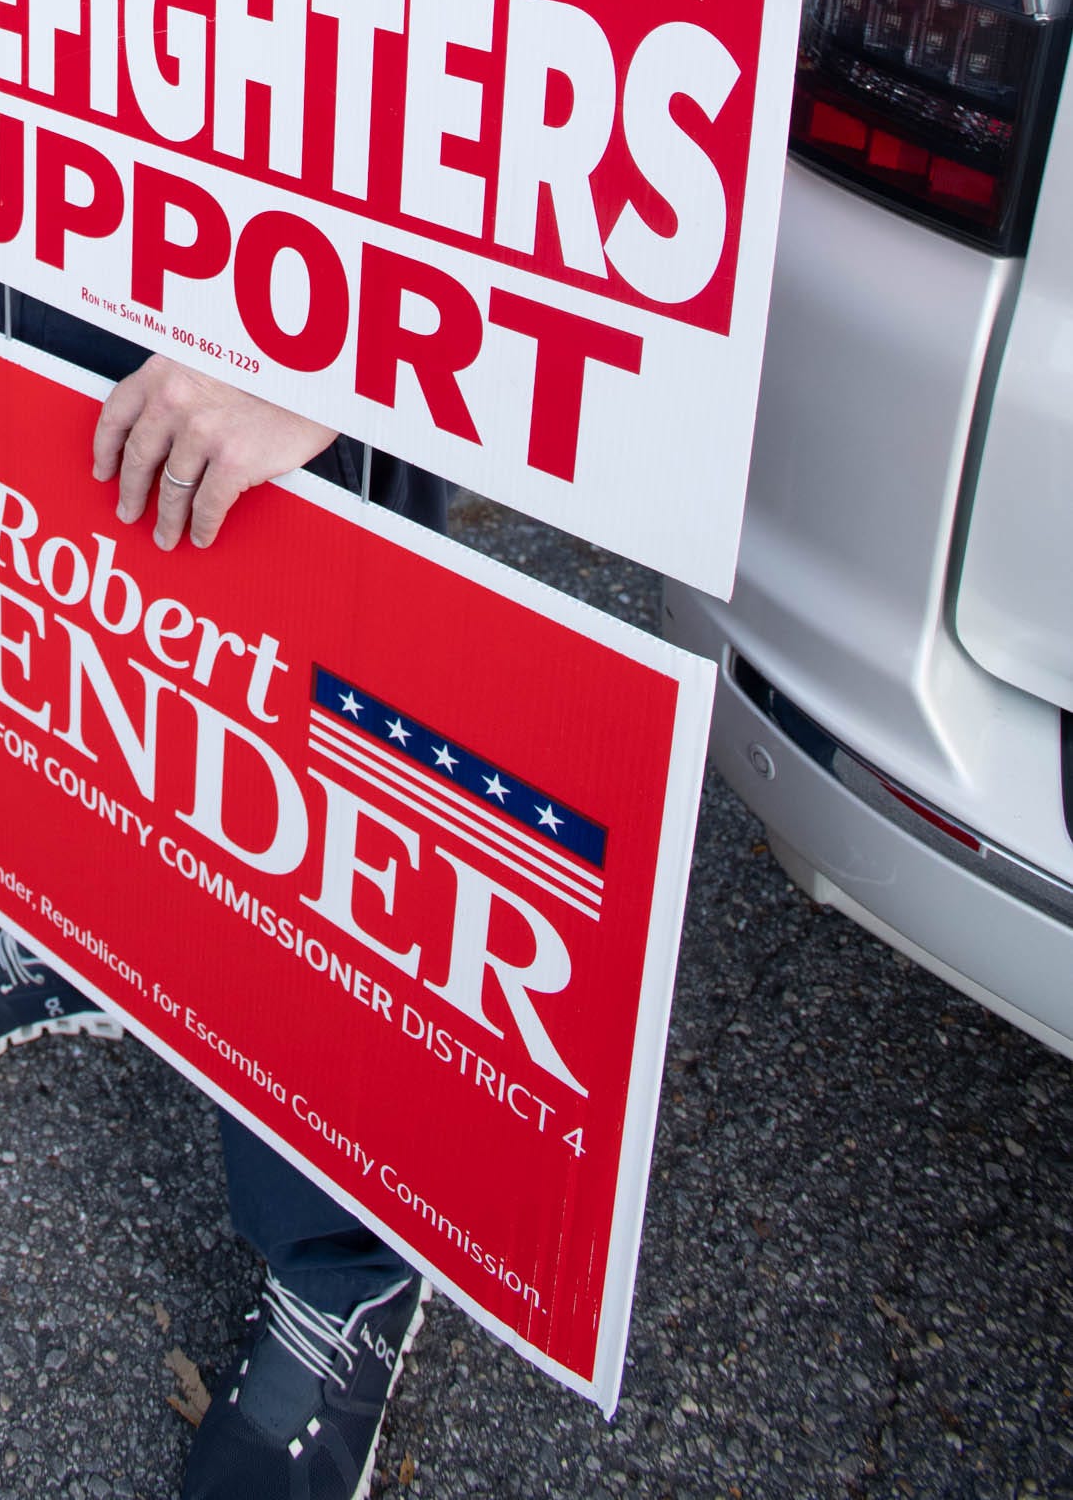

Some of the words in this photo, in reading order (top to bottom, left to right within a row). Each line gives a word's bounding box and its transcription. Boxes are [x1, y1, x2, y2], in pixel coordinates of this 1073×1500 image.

[172, 326, 260, 374] 800-862-1229
[41, 894, 148, 998] Republican,
[152, 983, 181, 1019] for
[185, 1007, 287, 1105] Escambia
[292, 1094, 375, 1176] County
[379, 1164, 548, 1315] Commission.
[44, 756, 153, 847] COUNTY
[158, 836, 393, 1023] COMMISSIONER
[402, 1003, 556, 1133] DISTRICT
[562, 1127, 586, 1158] 4
